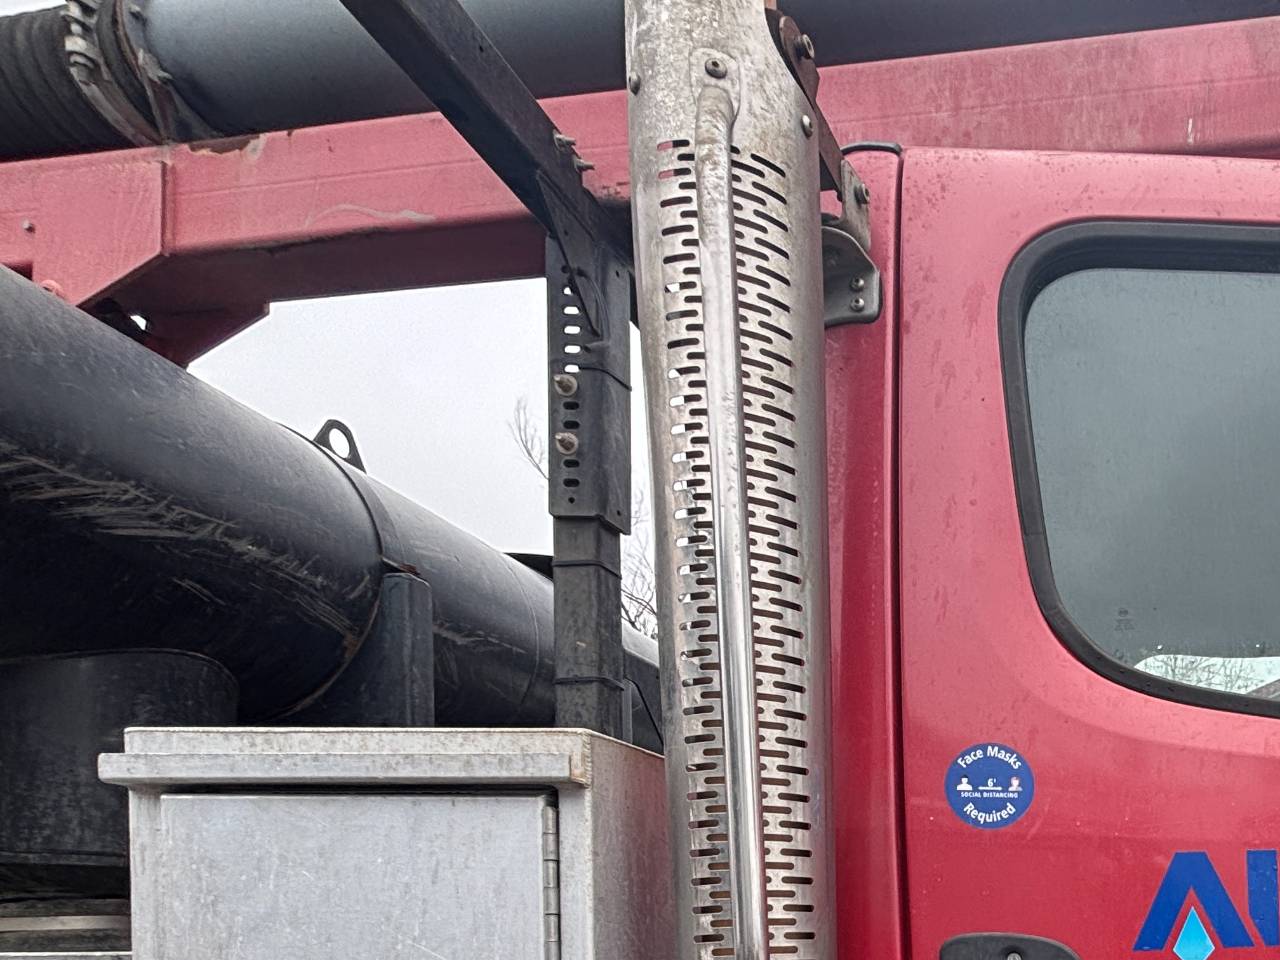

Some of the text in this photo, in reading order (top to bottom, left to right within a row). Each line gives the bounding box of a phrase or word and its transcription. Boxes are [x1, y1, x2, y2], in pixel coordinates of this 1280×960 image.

[957, 745, 1022, 770] Face Masks
[963, 802, 1016, 825] Required
